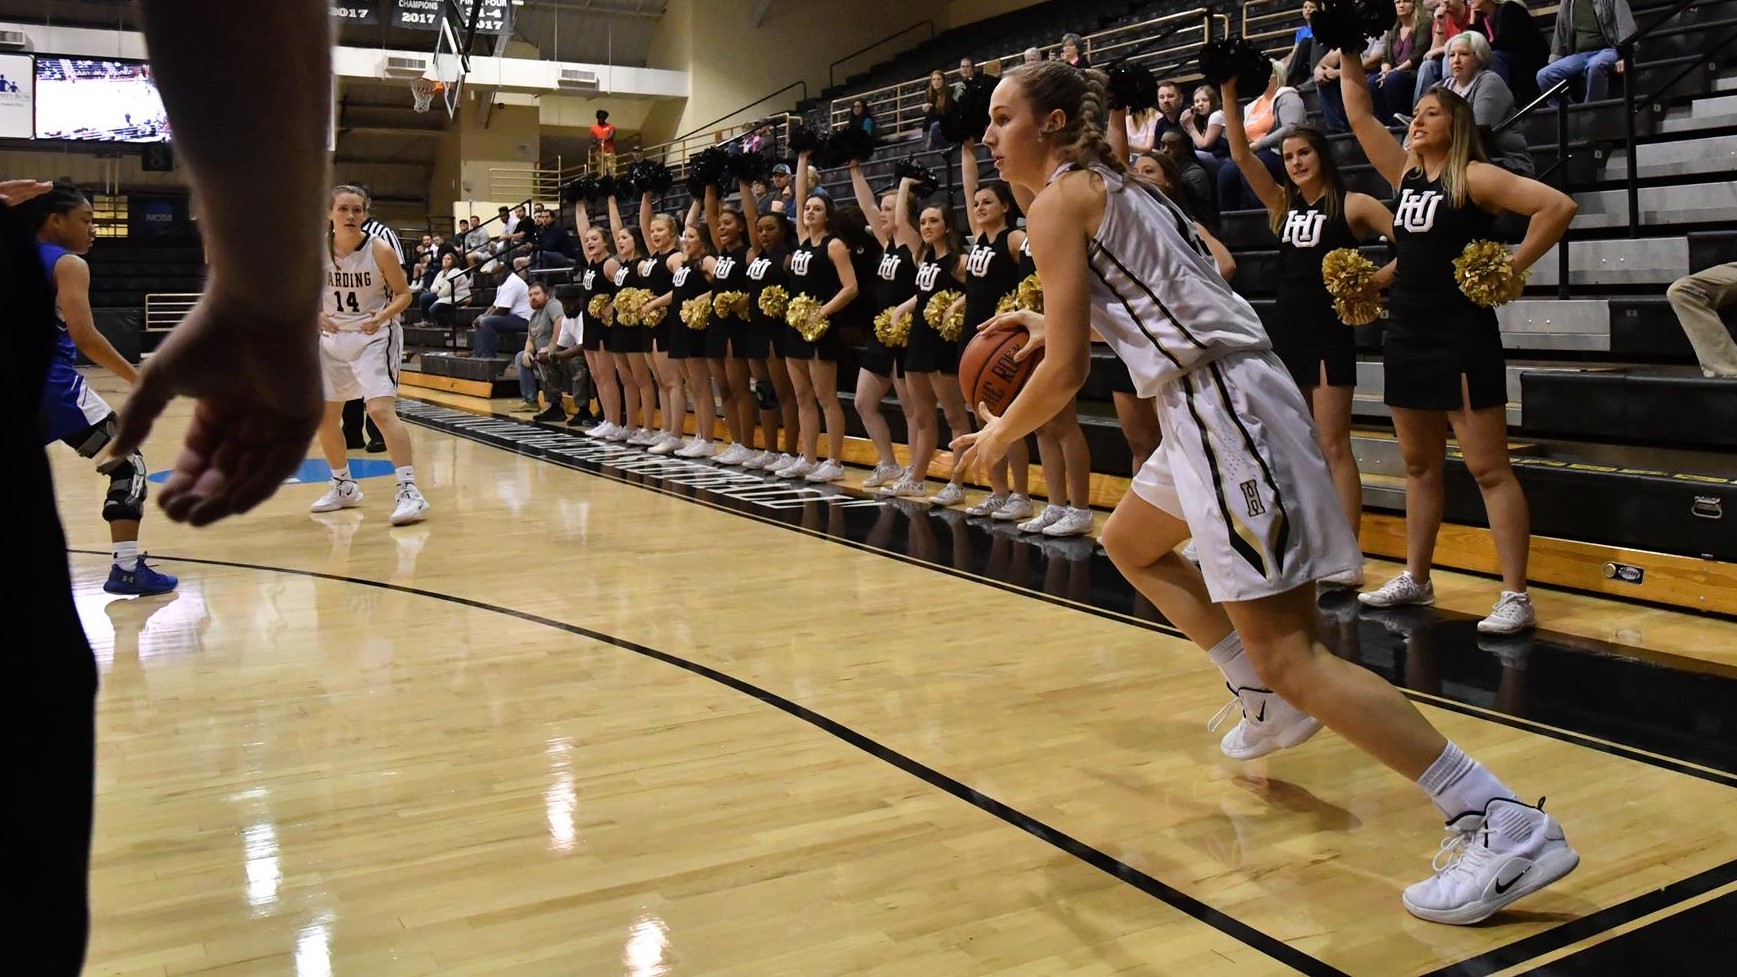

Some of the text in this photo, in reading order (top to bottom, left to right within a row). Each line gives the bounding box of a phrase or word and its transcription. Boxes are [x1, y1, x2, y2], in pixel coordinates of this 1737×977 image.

[398, 0, 438, 10] CHAMPIONS
[401, 12, 436, 24] 2017
[1394, 189, 1443, 233] HU
[1282, 210, 1327, 248] HU
[966, 245, 996, 278] HU
[328, 271, 371, 288] ARDING
[334, 290, 360, 312] 14
[1239, 479, 1265, 517] H
